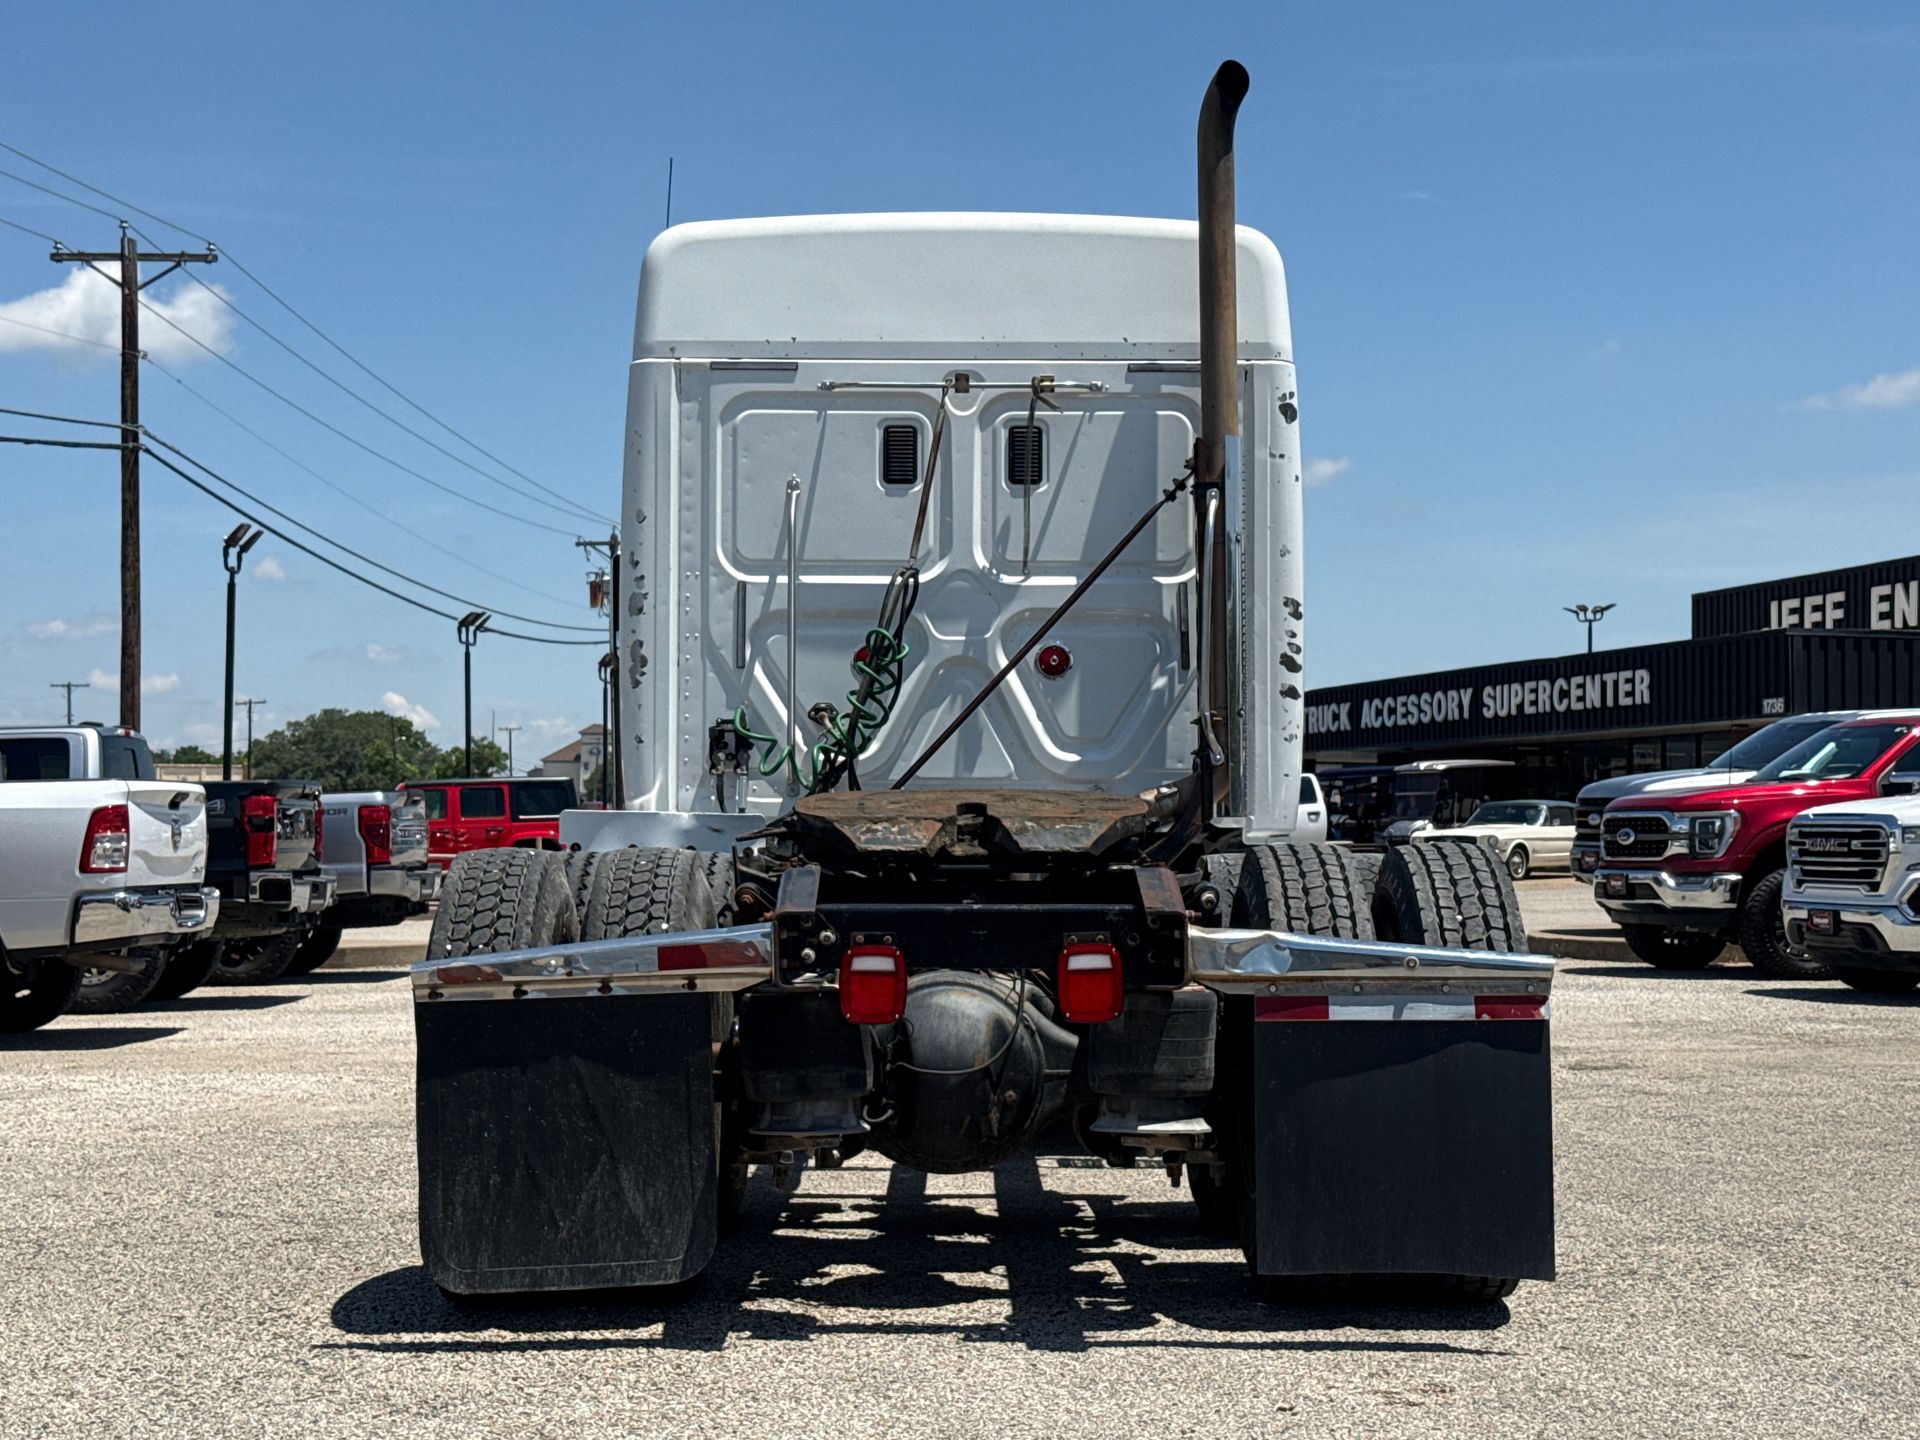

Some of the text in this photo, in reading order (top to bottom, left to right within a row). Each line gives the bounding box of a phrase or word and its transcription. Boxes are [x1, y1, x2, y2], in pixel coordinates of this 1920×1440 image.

[1360, 687, 1474, 729] ACCESSORY
[1482, 668, 1651, 719] SUPERCENTER
[1762, 698, 1785, 714] 1736
[1808, 838, 1849, 852] GMC
